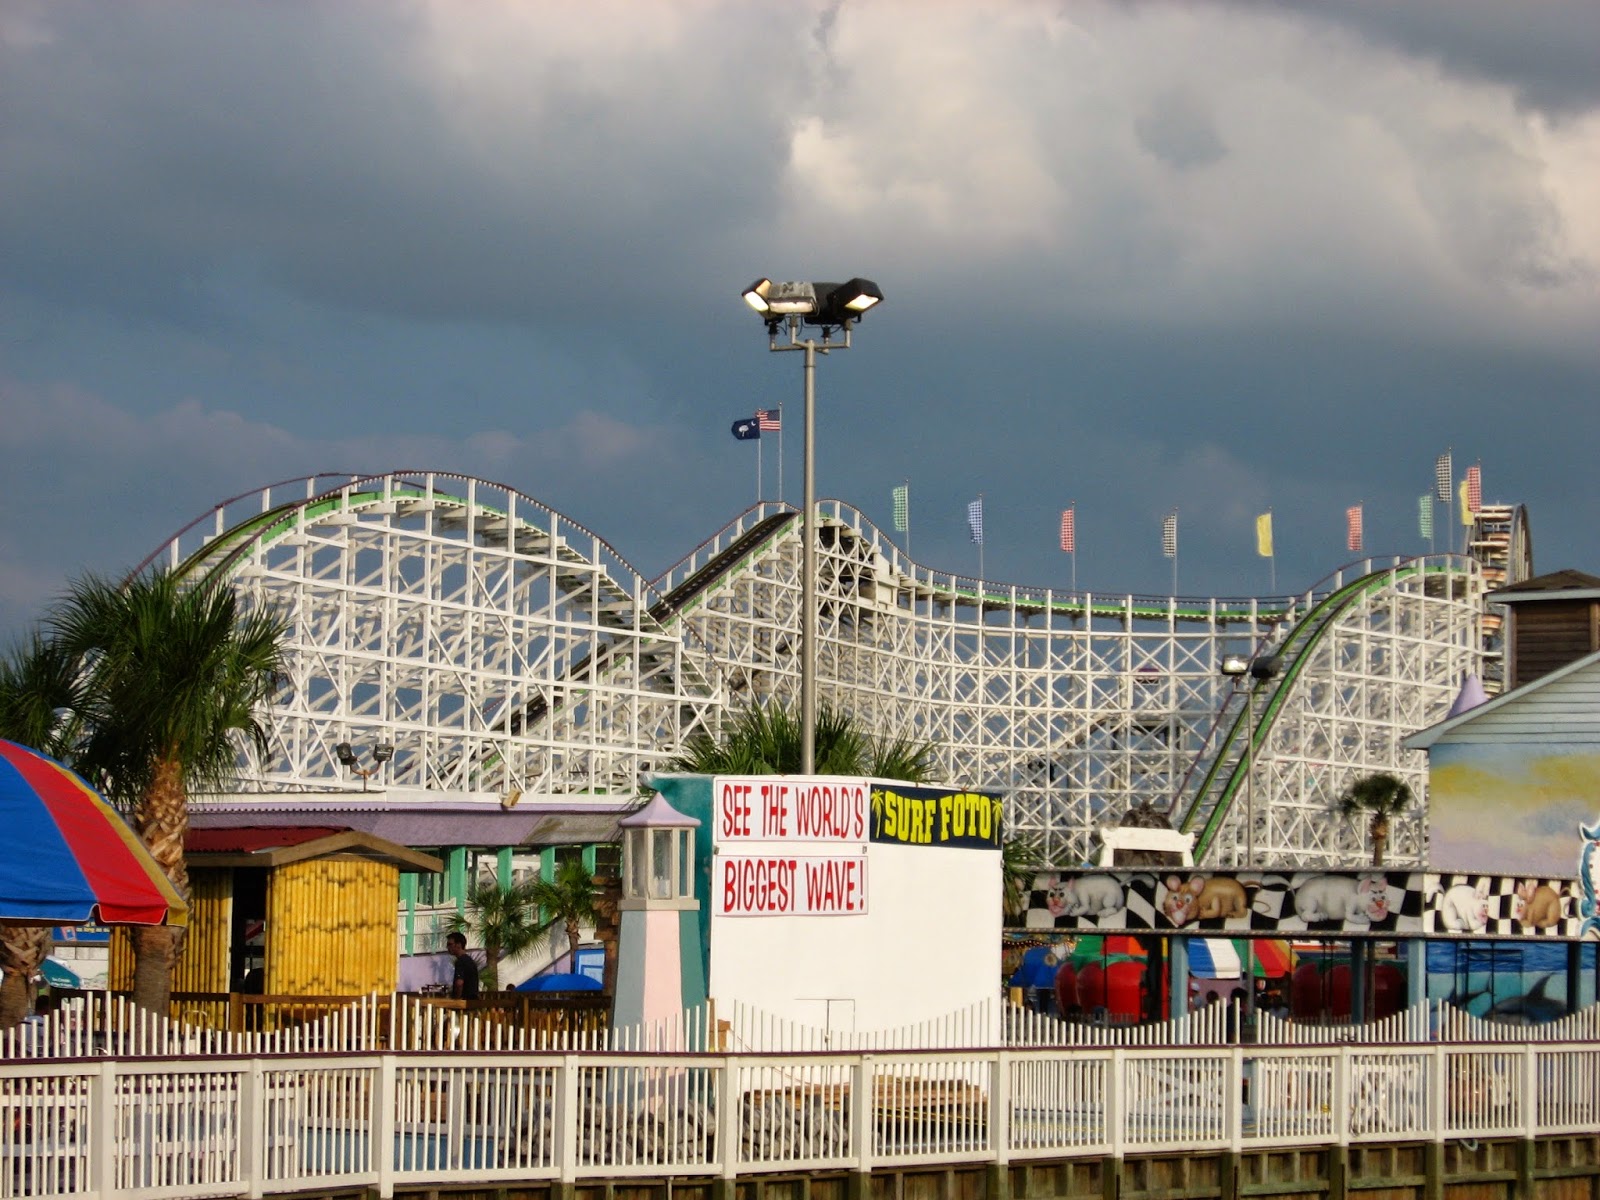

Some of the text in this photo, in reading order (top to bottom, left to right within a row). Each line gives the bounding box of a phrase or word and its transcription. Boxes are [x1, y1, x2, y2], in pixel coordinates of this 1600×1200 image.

[722, 784, 864, 839] SEE THE WORLD'S
[884, 790, 992, 844] SURF FOTO
[723, 859, 864, 912] BIGGEST WAVE!
